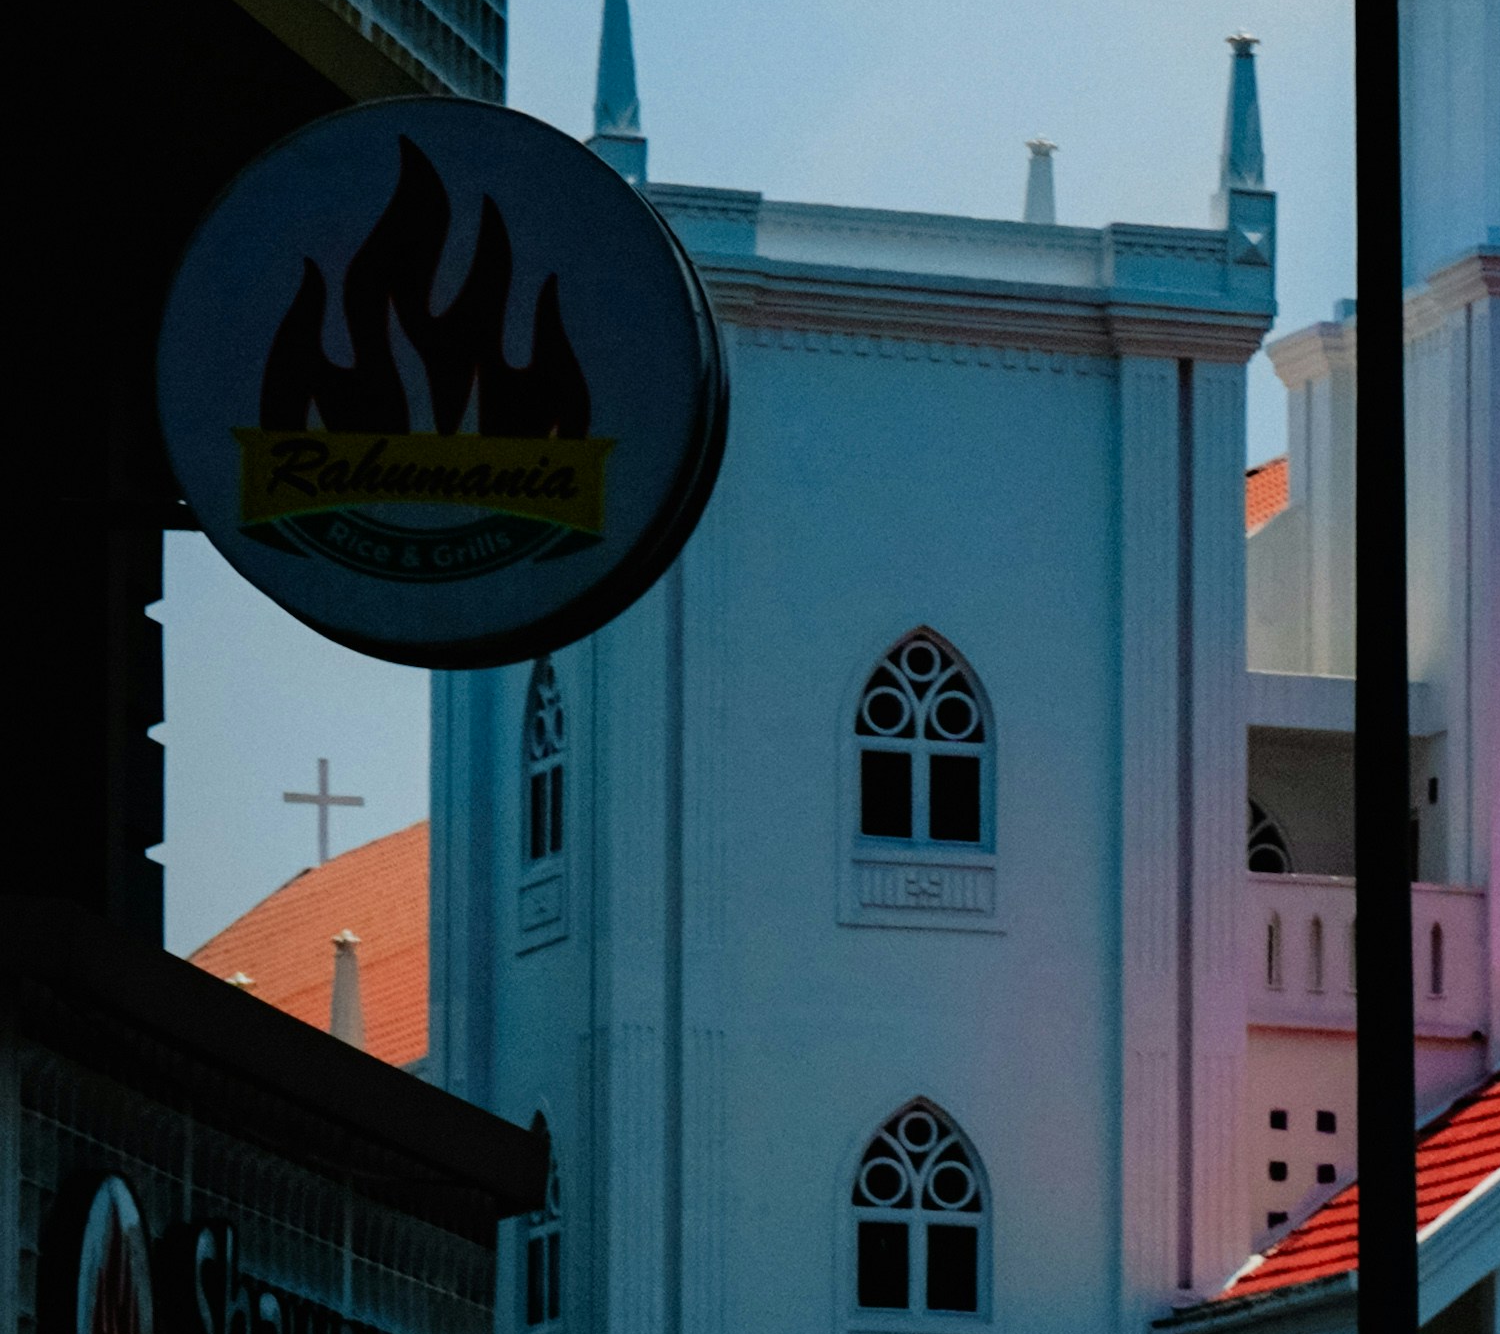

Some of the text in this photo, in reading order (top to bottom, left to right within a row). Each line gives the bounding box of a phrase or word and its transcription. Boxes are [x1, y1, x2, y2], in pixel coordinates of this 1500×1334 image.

[266, 437, 579, 500] Rahumania
[324, 519, 512, 568] Rice & Grills
